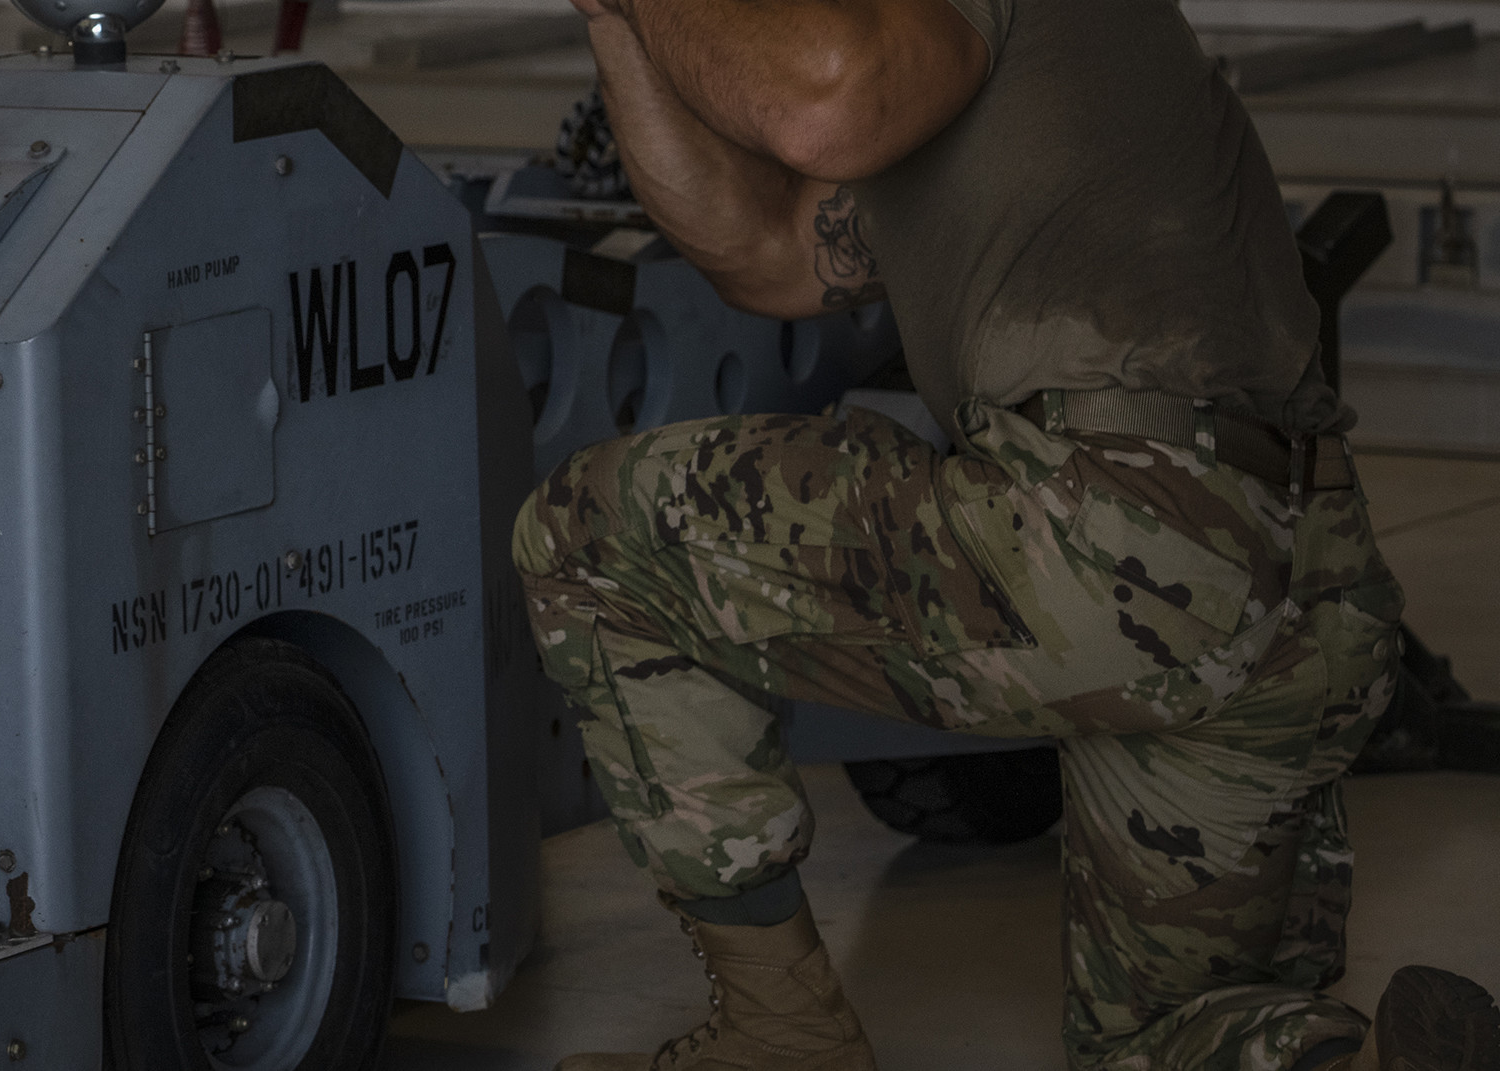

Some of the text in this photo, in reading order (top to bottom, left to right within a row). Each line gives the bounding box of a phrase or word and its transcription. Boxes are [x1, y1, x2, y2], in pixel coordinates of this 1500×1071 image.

[167, 255, 240, 288] HAND PUMP
[288, 241, 457, 404] WL07
[111, 519, 419, 655] NSN 1730-01-491-1557
[375, 588, 467, 629] TIRE PRESSURE
[400, 618, 444, 646] 100 PSI
